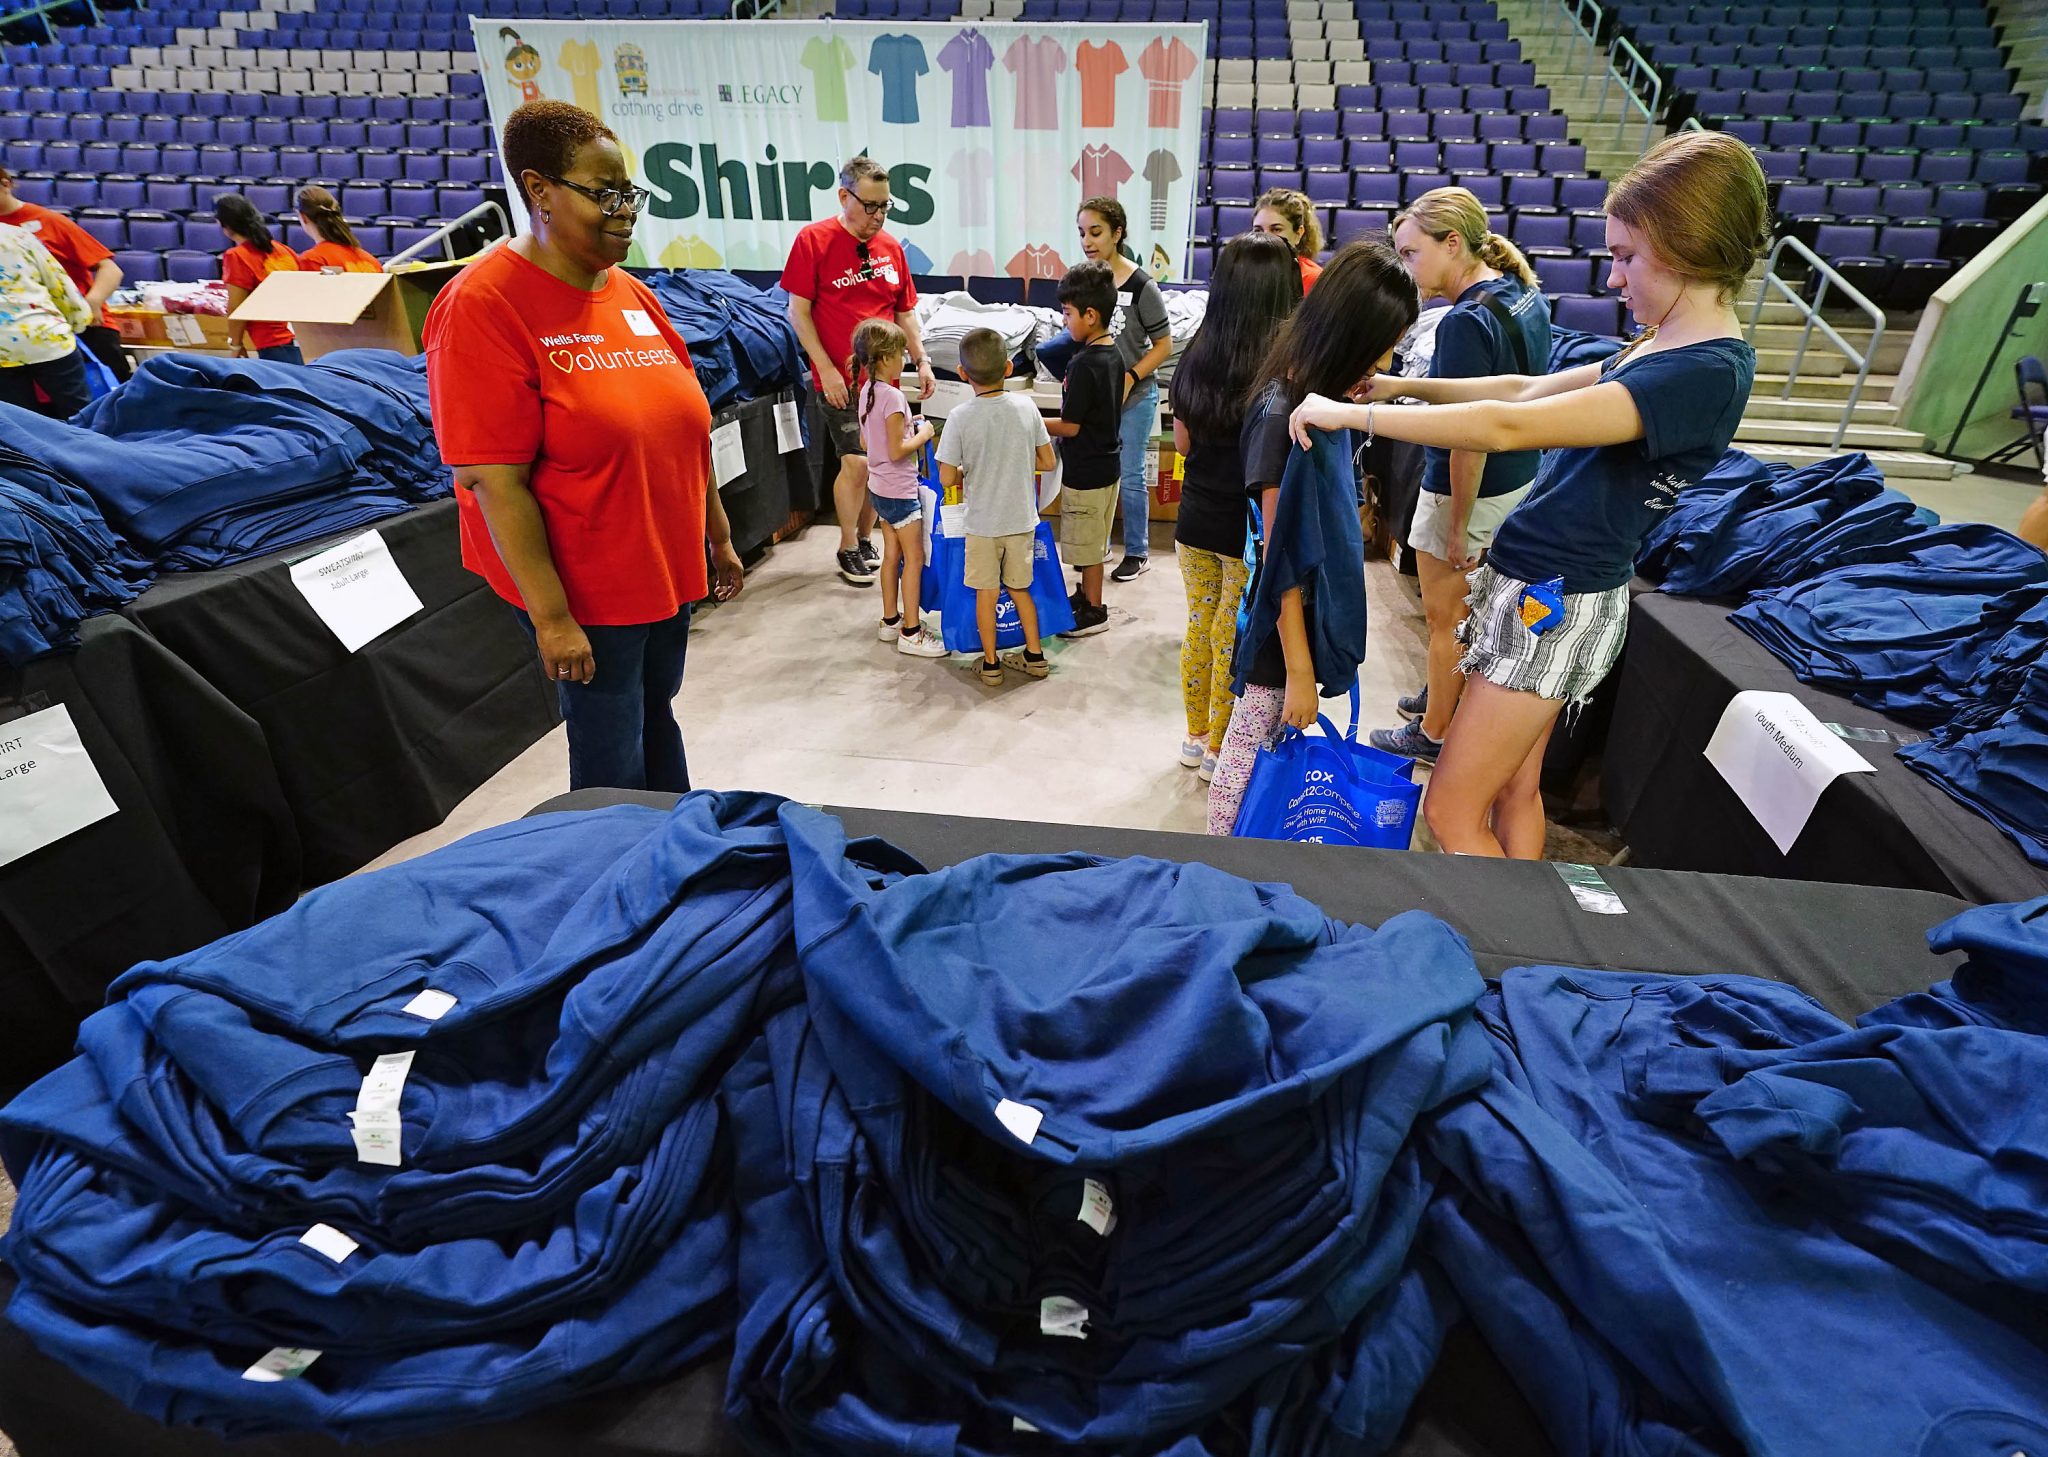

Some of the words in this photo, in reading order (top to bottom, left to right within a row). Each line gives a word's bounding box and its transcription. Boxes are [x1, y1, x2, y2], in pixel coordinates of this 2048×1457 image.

[643, 141, 935, 226] Shirs
[540, 334, 573, 348] Wells
[573, 333, 605, 346] Fargo
[330, 577, 350, 590] Adult
[348, 568, 369, 582] Large
[0, 737, 23, 755] IRT
[1754, 709, 1776, 736] Youth
[1772, 730, 1804, 769] Medium
[1303, 807, 1327, 816] Home
